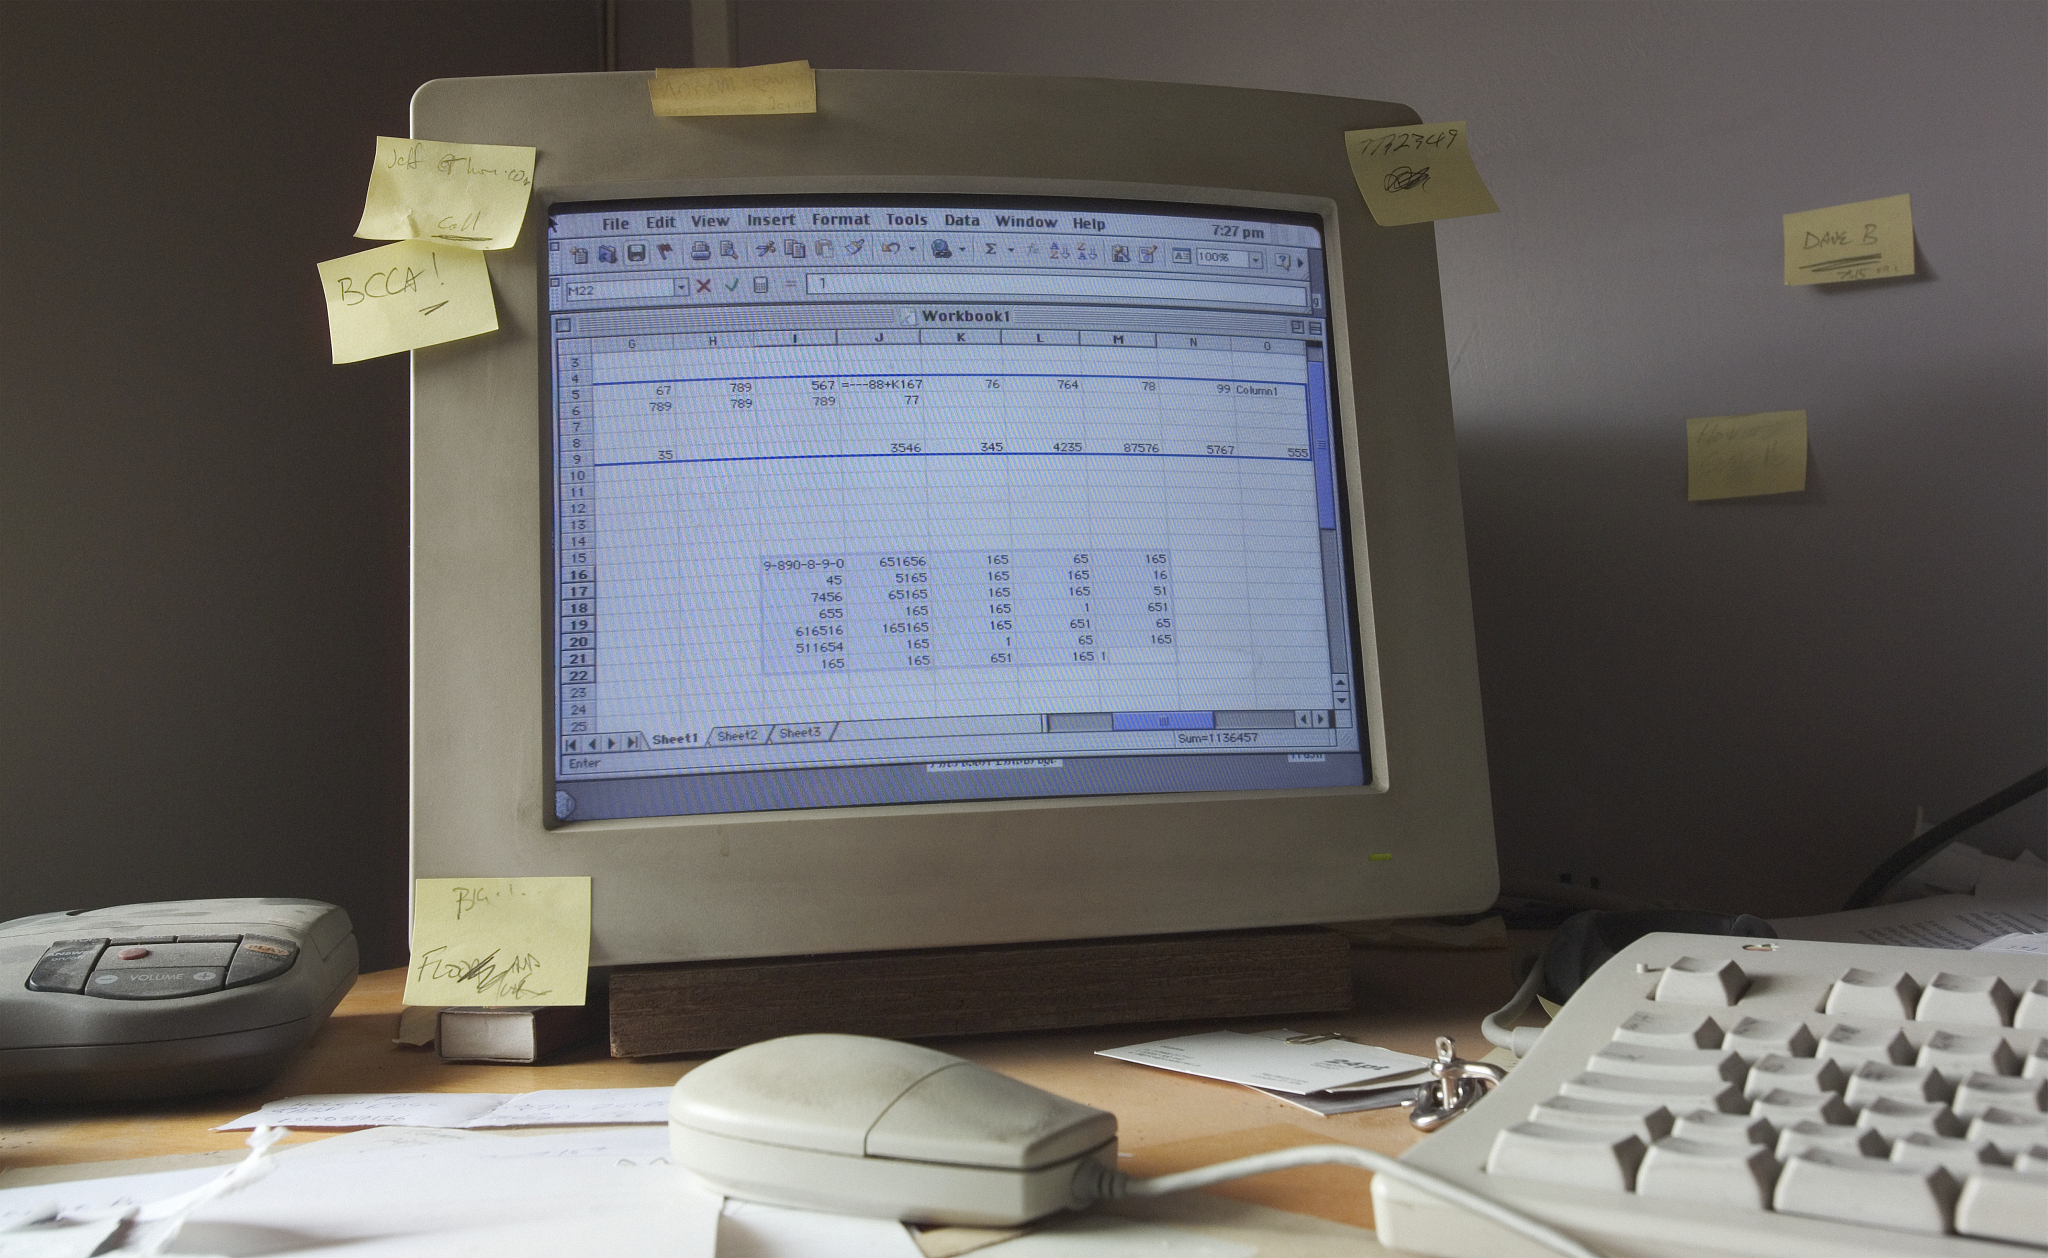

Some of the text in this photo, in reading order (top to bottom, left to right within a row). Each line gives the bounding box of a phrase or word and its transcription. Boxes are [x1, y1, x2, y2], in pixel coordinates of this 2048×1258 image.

[603, 213, 1264, 241] File Edit View Insert Format Tools Data Window Help 7:27 pm
[1198, 252, 1230, 263] 100%
[568, 284, 594, 296] M22
[923, 310, 1010, 324] Workbook1
[628, 340, 636, 349] G
[709, 336, 717, 346] H
[875, 333, 883, 342] J
[957, 333, 966, 342] K
[1037, 334, 1044, 342] L
[1113, 334, 1124, 344] M
[1190, 337, 1198, 346] N
[572, 358, 579, 368] 3
[572, 374, 580, 384] 4
[572, 390, 580, 400] 5
[656, 386, 672, 396] 67
[730, 382, 752, 393] 789
[811, 380, 835, 391] 567
[985, 378, 1000, 390] 76
[1057, 380, 1079, 390] 764
[1142, 381, 1156, 392] 78
[1216, 384, 1230, 394] 99
[1236, 385, 1278, 397] Column1
[572, 395, 920, 416] 6 789 789 789 77
[572, 422, 580, 432] 7
[573, 438, 581, 448] 8
[574, 442, 1309, 464] 9 35 3546 345 4235 87576 5767 555
[570, 470, 586, 480] 10
[570, 487, 584, 497] 11
[570, 504, 586, 514] 12
[571, 520, 586, 530] 13
[571, 536, 586, 546] 14
[571, 553, 1167, 571] 15 9-890-8-9-0 651656 165 65 165
[570, 570, 1168, 586] 16 45 5165 165 165 16
[570, 586, 1168, 603] 17 7456 65165 165 165 51
[570, 603, 588, 614] 18
[818, 608, 844, 620] 655
[906, 606, 928, 617] 165
[989, 604, 1012, 615] 165
[1148, 602, 1168, 613] 651
[570, 618, 1172, 636] 19 616516 165165 165 651 65
[569, 636, 588, 648] 20
[796, 642, 844, 653] 511654
[906, 638, 930, 650] 165
[1078, 635, 1094, 646] 65
[1150, 634, 1172, 646] 165
[569, 654, 586, 664] 21
[822, 658, 845, 670] 165
[908, 656, 930, 666] 165
[990, 653, 1012, 664] 651
[1072, 652, 1095, 663] 165
[569, 670, 588, 682] 22
[570, 688, 587, 698] 23
[570, 704, 588, 716] 24
[570, 722, 588, 732] 25
[652, 726, 822, 746] Sheet1 Sheet2 Sheet3
[569, 732, 1258, 769] Enter Sum=1136457
[130, 973, 184, 981] VOLUME
